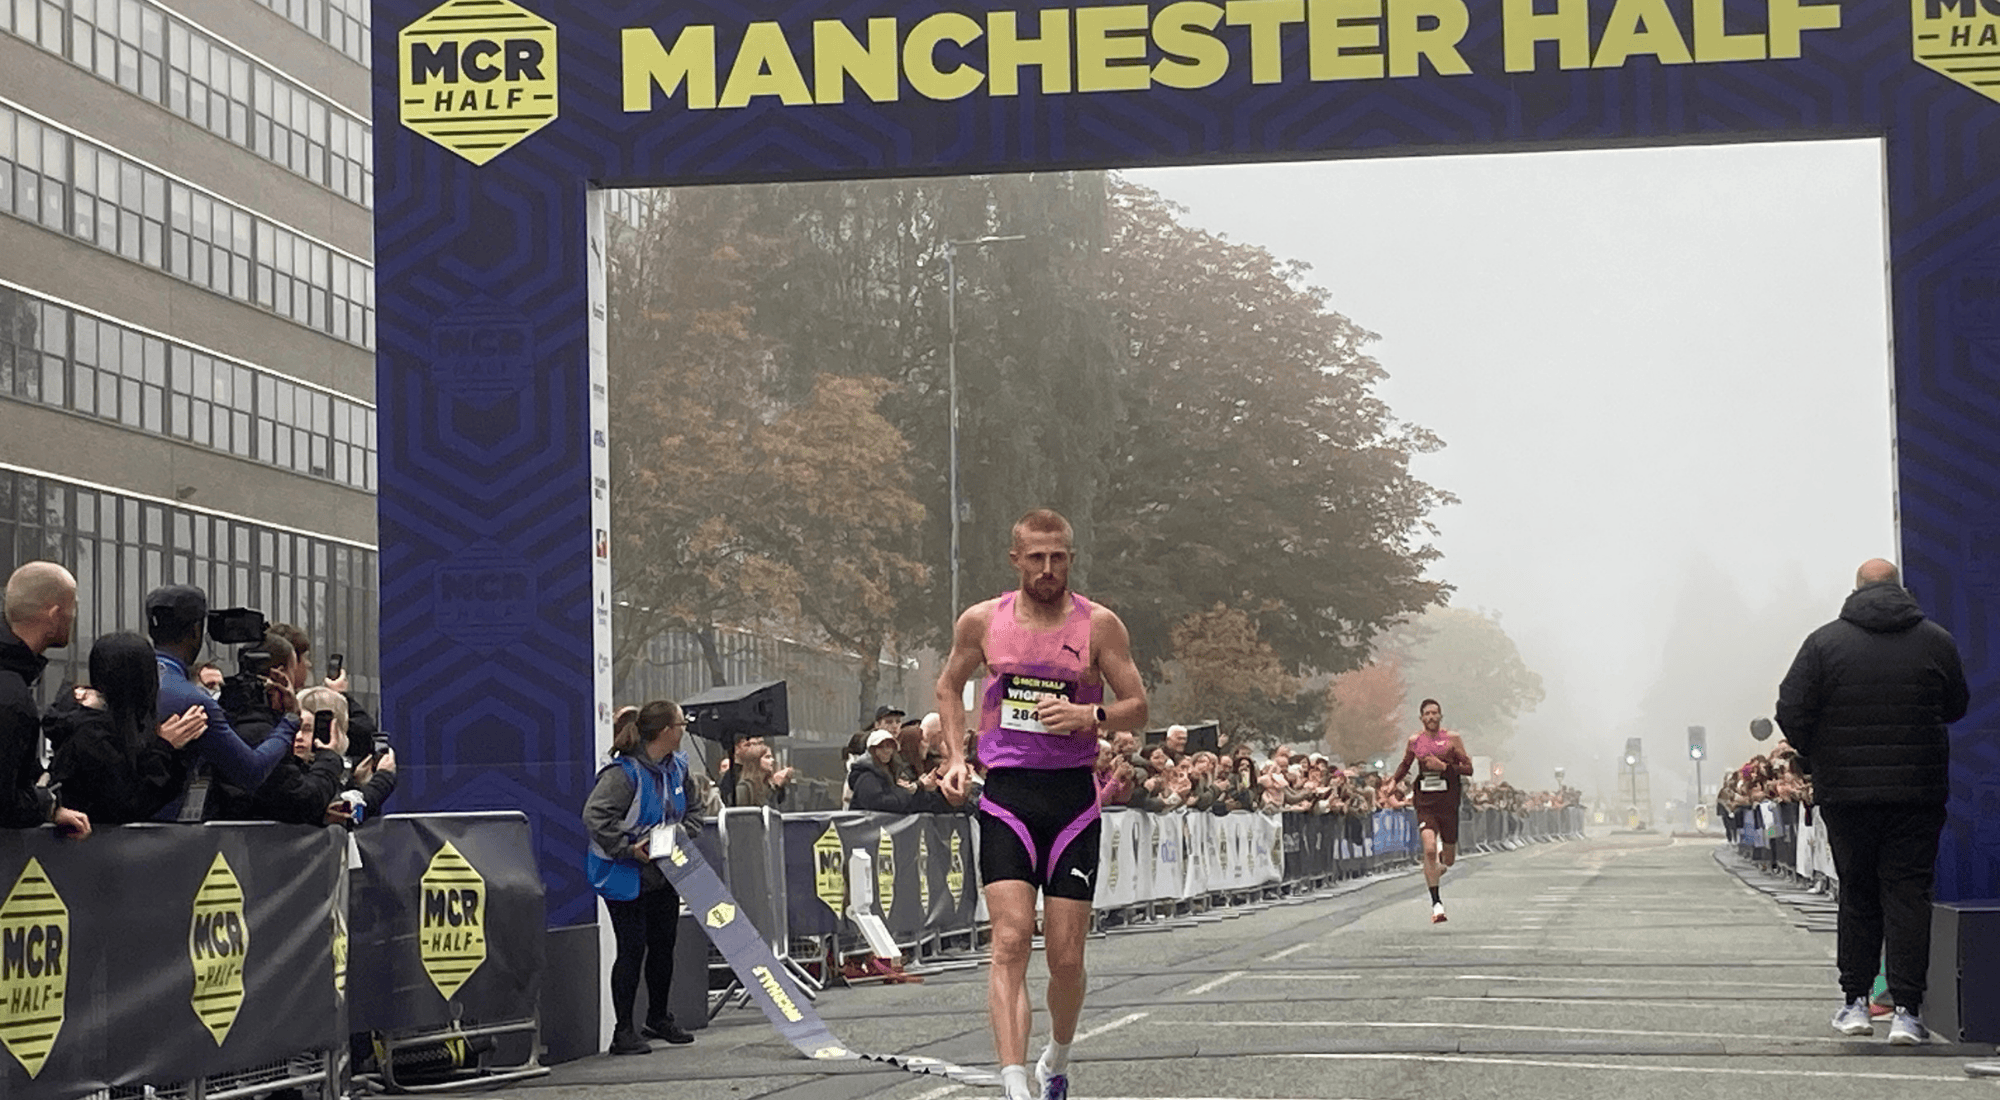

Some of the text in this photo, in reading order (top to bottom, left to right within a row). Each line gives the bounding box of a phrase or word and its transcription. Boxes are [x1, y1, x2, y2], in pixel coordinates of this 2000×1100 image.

[411, 39, 545, 85] MCR
[621, 0, 1841, 113] MANCHESTER HALF
[434, 88, 523, 112] HALF
[424, 888, 479, 928] MCR
[3, 924, 63, 981] MCR
[194, 911, 244, 960] MCR
[432, 931, 472, 952] HALF
[205, 963, 236, 988] HALF
[11, 984, 52, 1014] HALF
